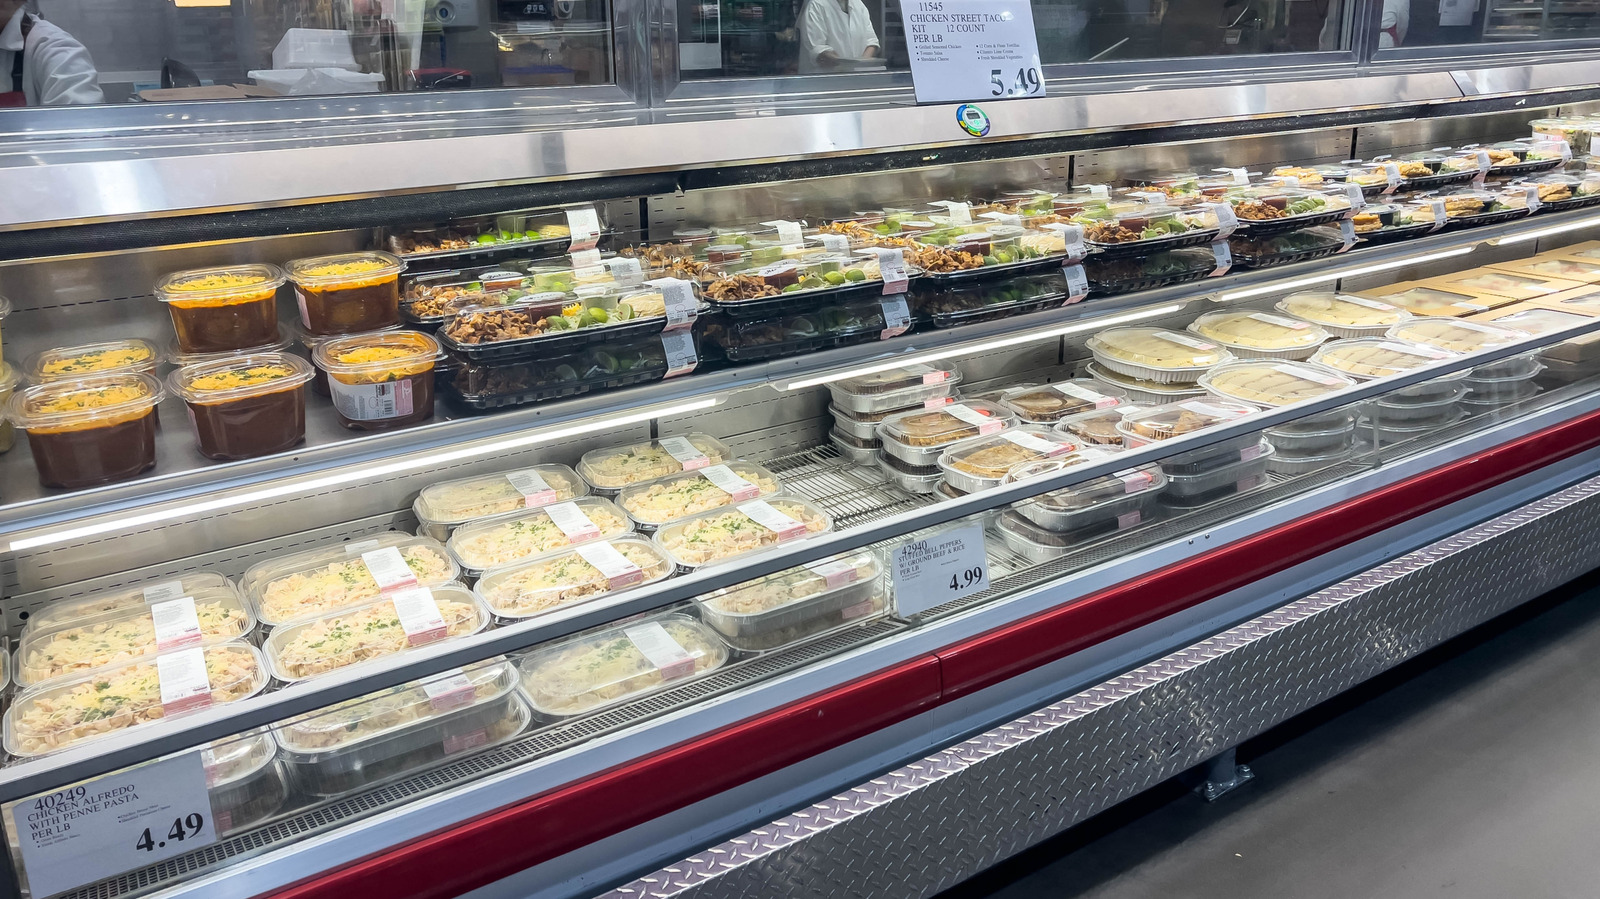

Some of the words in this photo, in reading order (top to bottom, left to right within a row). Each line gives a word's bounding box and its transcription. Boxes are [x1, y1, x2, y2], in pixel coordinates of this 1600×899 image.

[919, 2, 944, 11] 11545
[910, 14, 949, 23] CHICKEN
[951, 13, 982, 23] STREET
[911, 24, 927, 33] KIT
[946, 24, 955, 33] 12
[957, 23, 986, 33] COUNT
[913, 34, 930, 43] PER
[932, 34, 944, 43] LB
[991, 67, 1041, 96] 5.49
[902, 540, 927, 555] 42940
[908, 555, 932, 567] GROUND
[933, 550, 946, 559] BEEF
[953, 544, 966, 553] RICE
[925, 546, 938, 556] BELL
[940, 539, 962, 550] PEPPERS
[900, 566, 911, 576] PER
[912, 565, 920, 573] LB
[949, 566, 983, 591] 4.99
[27, 802, 79, 822] CHICKEN
[82, 784, 135, 806] ALFREDO
[34, 786, 87, 811] 40249
[29, 815, 60, 831] WITH
[63, 805, 101, 822] PENNE
[104, 793, 139, 809] PASTA
[31, 828, 53, 841] PER
[56, 822, 71, 833] LB
[136, 812, 204, 852] 4.49
